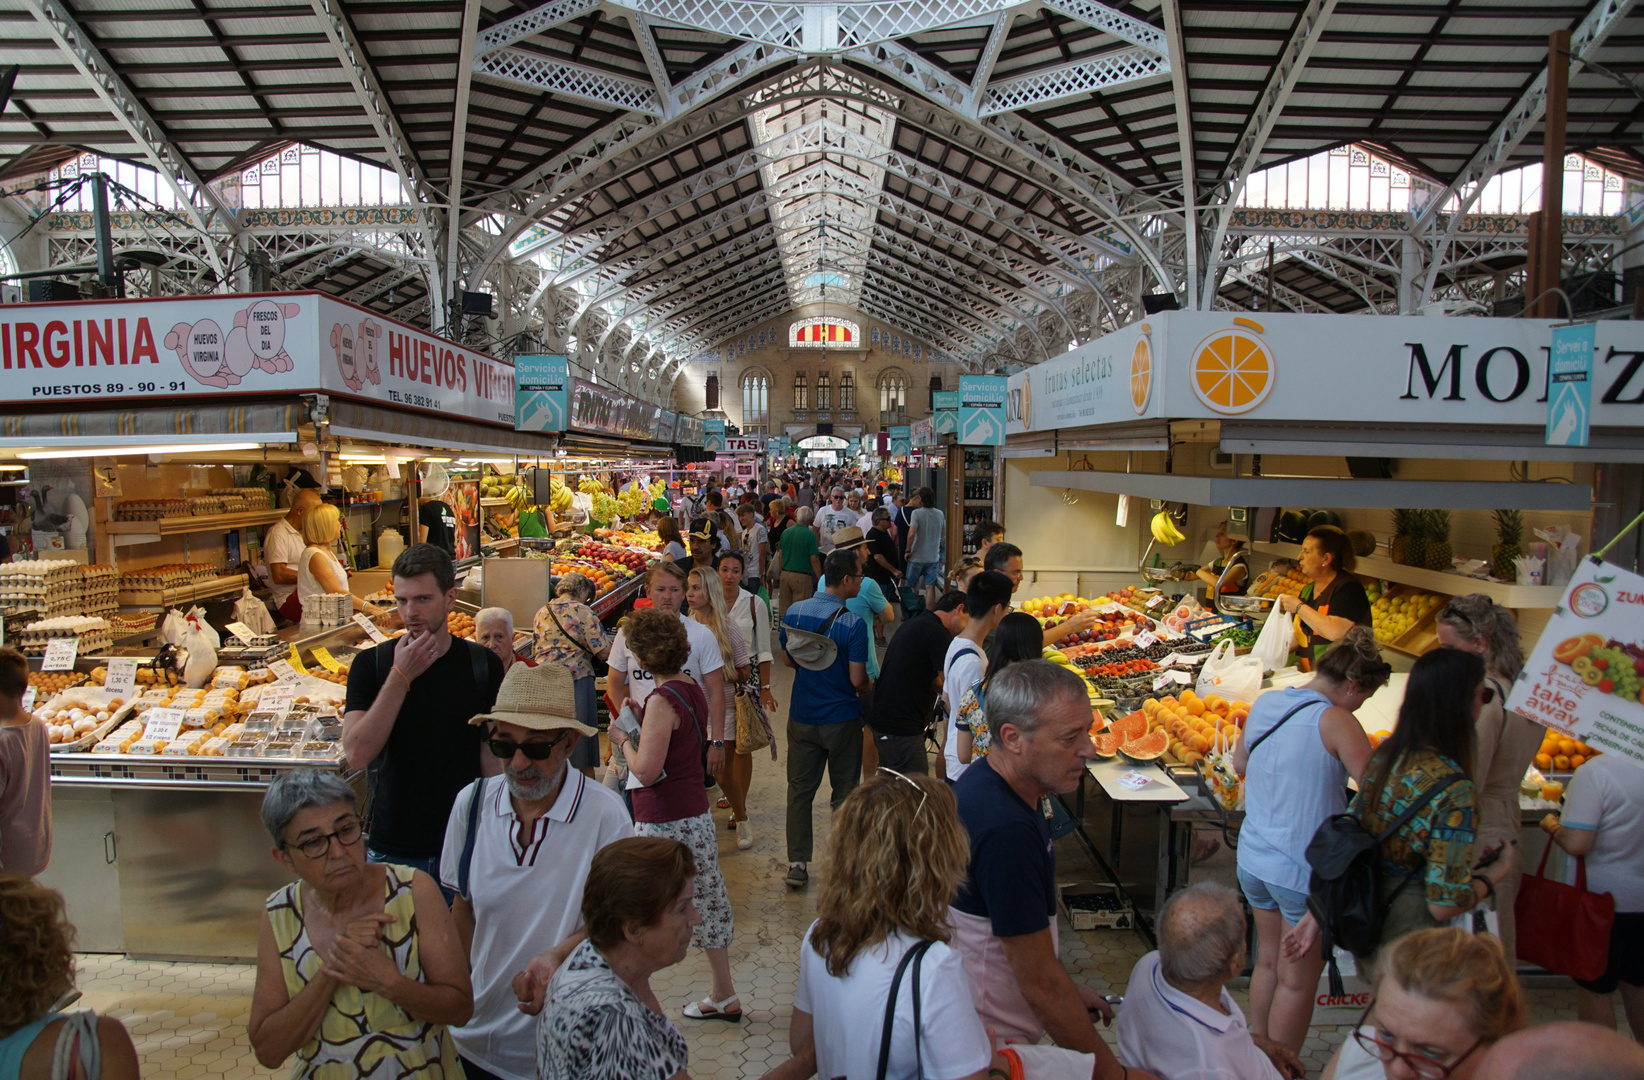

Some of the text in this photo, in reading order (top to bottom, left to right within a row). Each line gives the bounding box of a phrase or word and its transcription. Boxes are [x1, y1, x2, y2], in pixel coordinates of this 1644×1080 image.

[253, 311, 278, 321] FRESCOS
[261, 326, 271, 335] DEL
[194, 334, 218, 345] HUEVOS
[261, 341, 271, 350] DIA
[193, 351, 219, 362] VIRGINIA
[388, 330, 467, 393] HUEVOS
[473, 359, 515, 407] VIRGI
[518, 362, 565, 373] Servicio a
[519, 374, 564, 384] domicilio
[1045, 355, 1112, 395] frutas selectas
[32, 384, 102, 396] PUESTOS
[106, 383, 124, 393] 89
[137, 382, 155, 392] 90
[169, 381, 186, 391] 91
[962, 381, 998, 392] Servicio
[389, 390, 441, 409] TEL. 96 382 91 41
[963, 392, 1004, 402] domicilio
[727, 440, 758, 450] TAS
[1532, 683, 1577, 712] take
[1525, 697, 1580, 728] away
[1599, 711, 1644, 735] CONTENIDO
[1593, 721, 1618, 737] FECHA
[1619, 732, 1631, 742] DE
[1587, 731, 1634, 757] CONSERVAR
